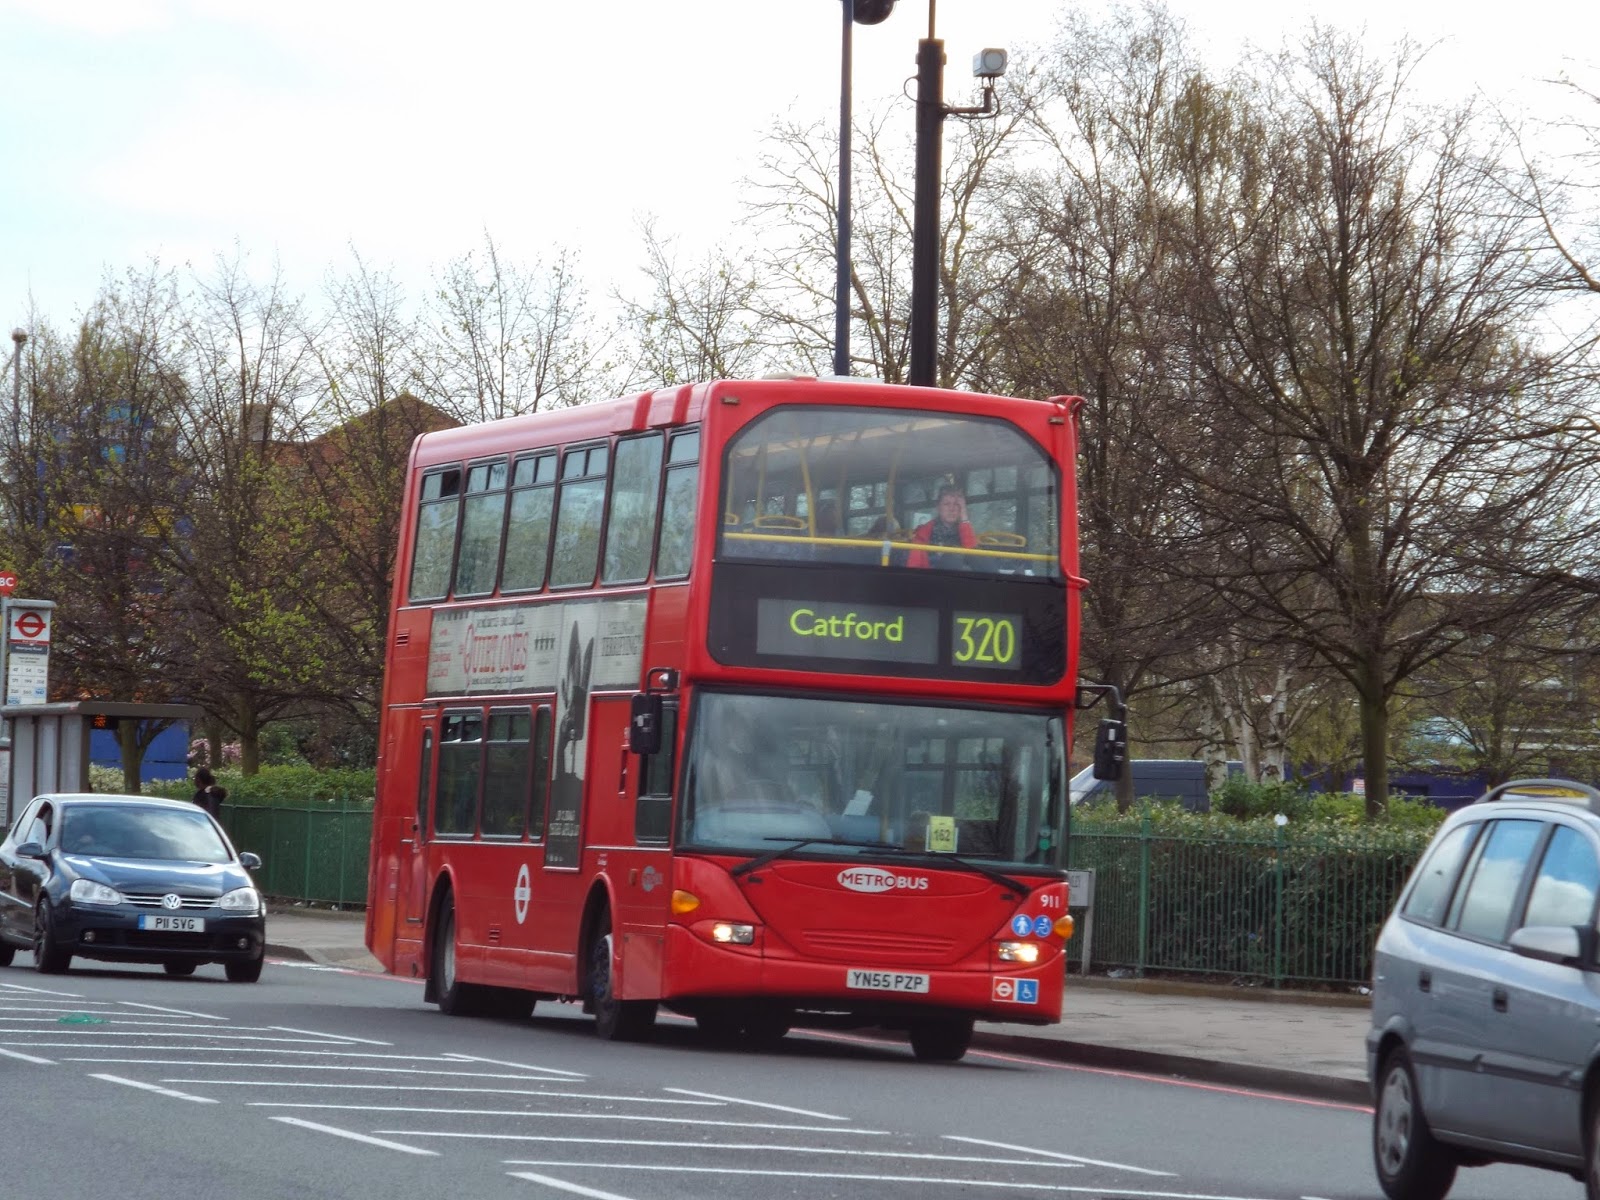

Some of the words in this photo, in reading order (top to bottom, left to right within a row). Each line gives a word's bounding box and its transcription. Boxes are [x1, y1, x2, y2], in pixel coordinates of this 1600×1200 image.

[0, 577, 14, 586] BC
[790, 609, 903, 641] Catford
[955, 617, 1015, 663] 320
[841, 872, 929, 890] METROBUS
[1040, 894, 1060, 908] 911
[173, 918, 195, 930] SVG
[853, 971, 892, 988] YN55
[894, 974, 923, 990] PZP
